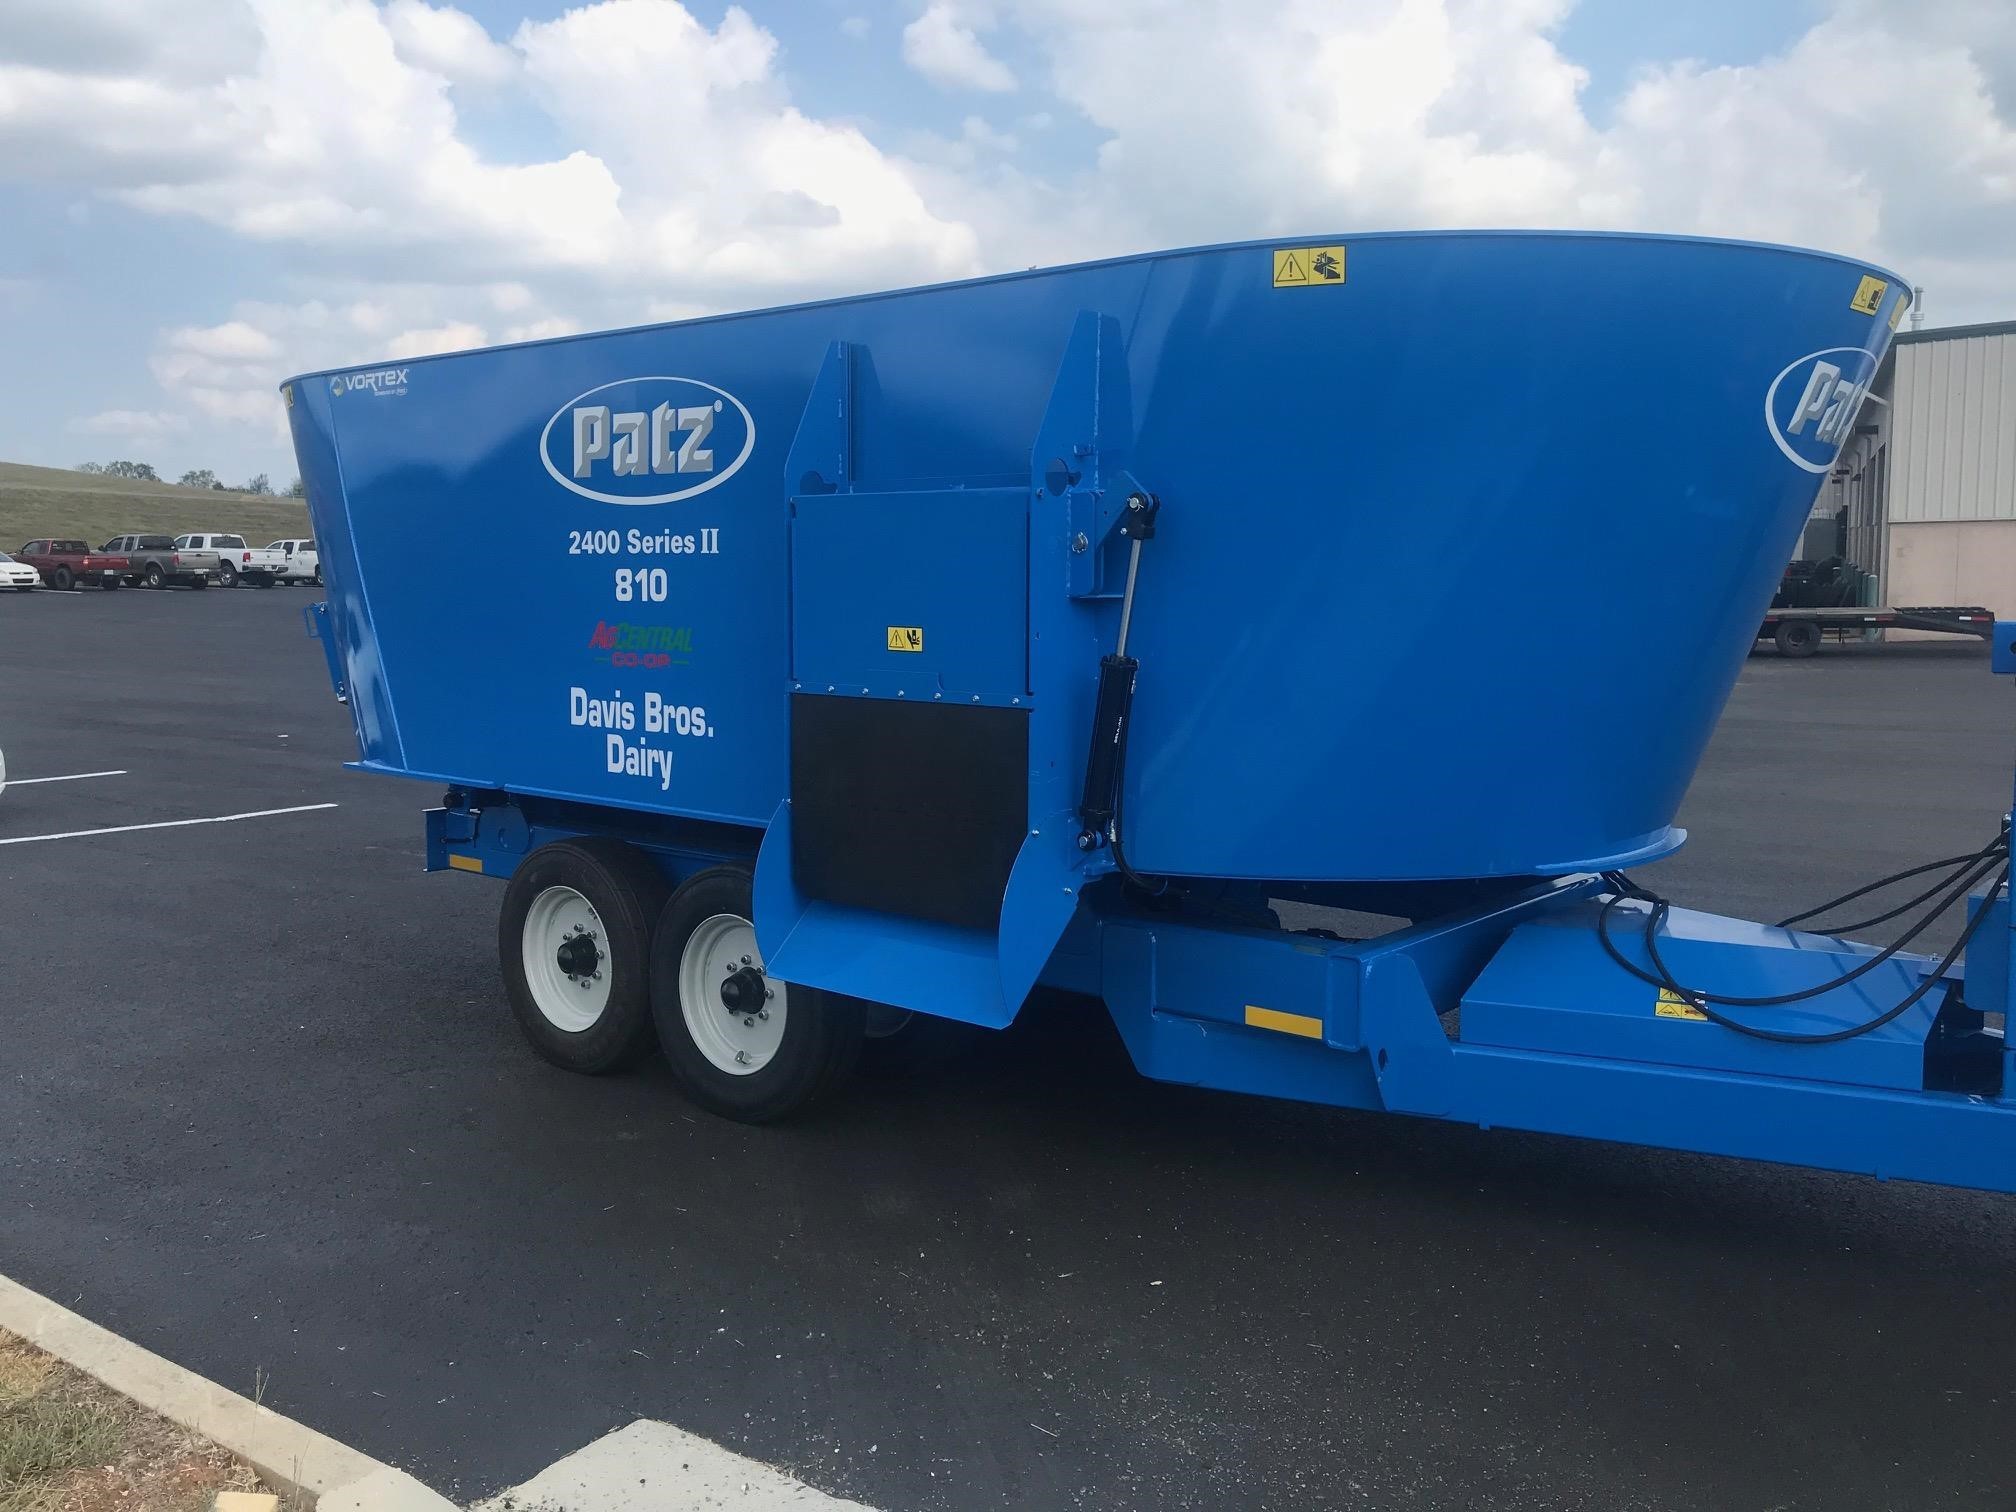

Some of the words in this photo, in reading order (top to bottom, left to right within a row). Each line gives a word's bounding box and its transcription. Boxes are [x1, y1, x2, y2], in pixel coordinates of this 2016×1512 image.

[1786, 360, 1863, 446] Pat
[573, 400, 714, 478] Patz
[568, 529, 620, 555] 2400
[627, 528, 696, 554] Series
[700, 528, 720, 554] II
[615, 568, 668, 602] 810
[570, 686, 635, 731] Davis
[644, 691, 714, 738] Bros.
[606, 733, 674, 791] Dairy
